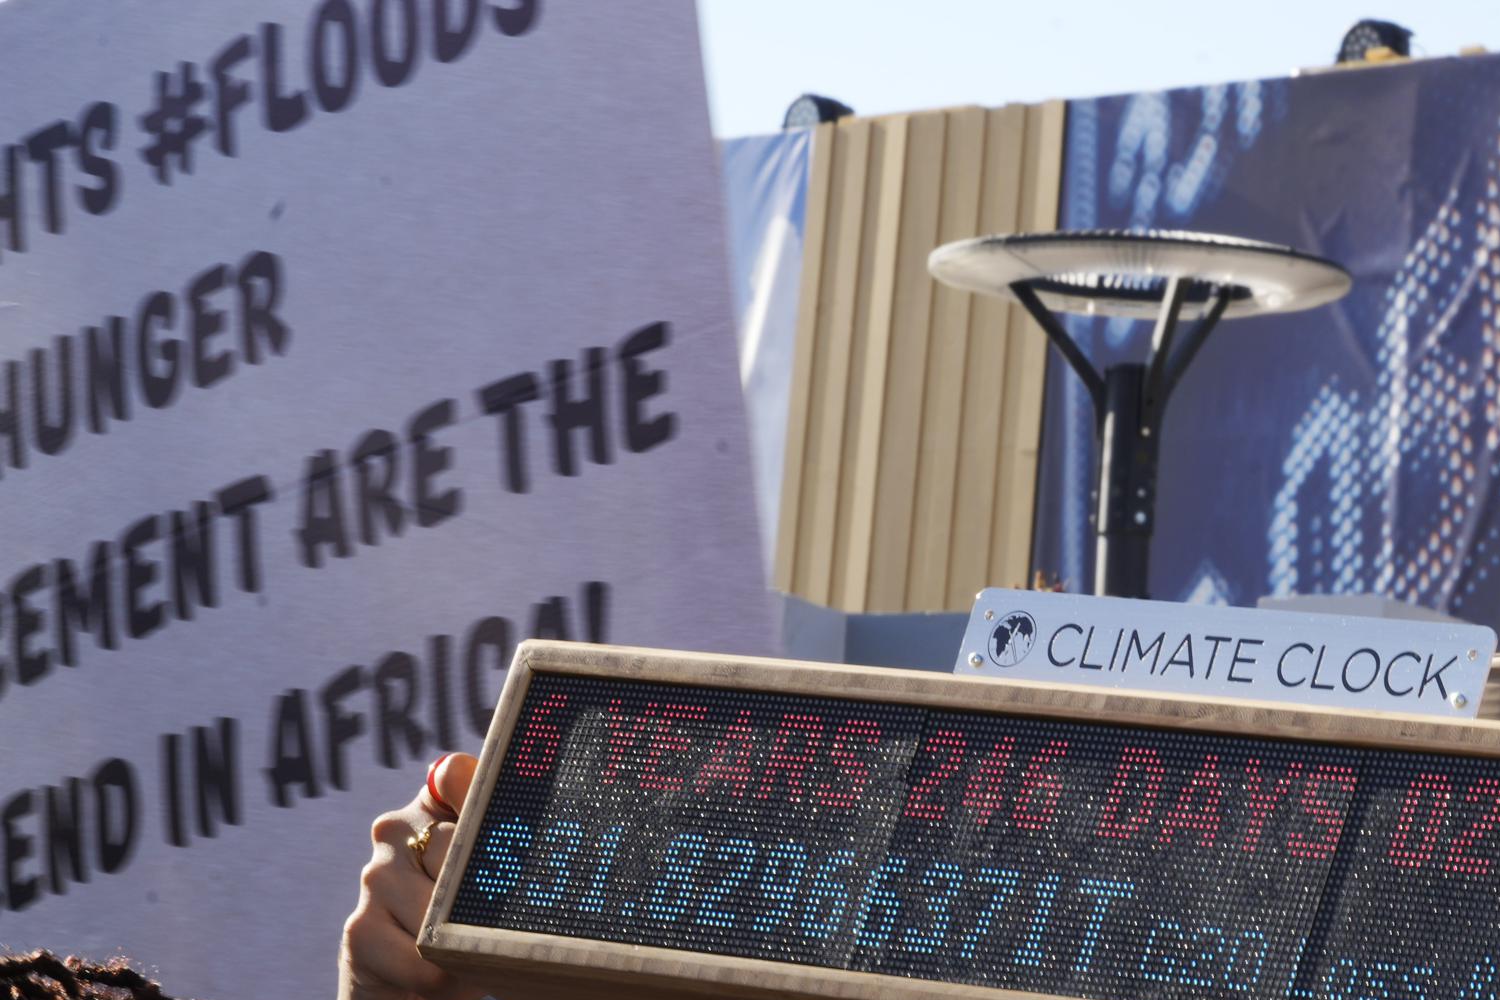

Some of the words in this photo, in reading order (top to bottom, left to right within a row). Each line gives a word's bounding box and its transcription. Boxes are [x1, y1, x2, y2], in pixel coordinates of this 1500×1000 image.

[0, 474, 275, 700] EMENT
[293, 398, 466, 569] ARE
[474, 320, 678, 494] THE
[1046, 622, 1265, 684] CLIMATE
[1276, 642, 1458, 700] CLOCK
[158, 715, 244, 848] IN
[515, 694, 568, 778] 6
[604, 699, 882, 808] YEARS
[903, 730, 1070, 829] 246
[1095, 747, 1358, 860] DAYS
